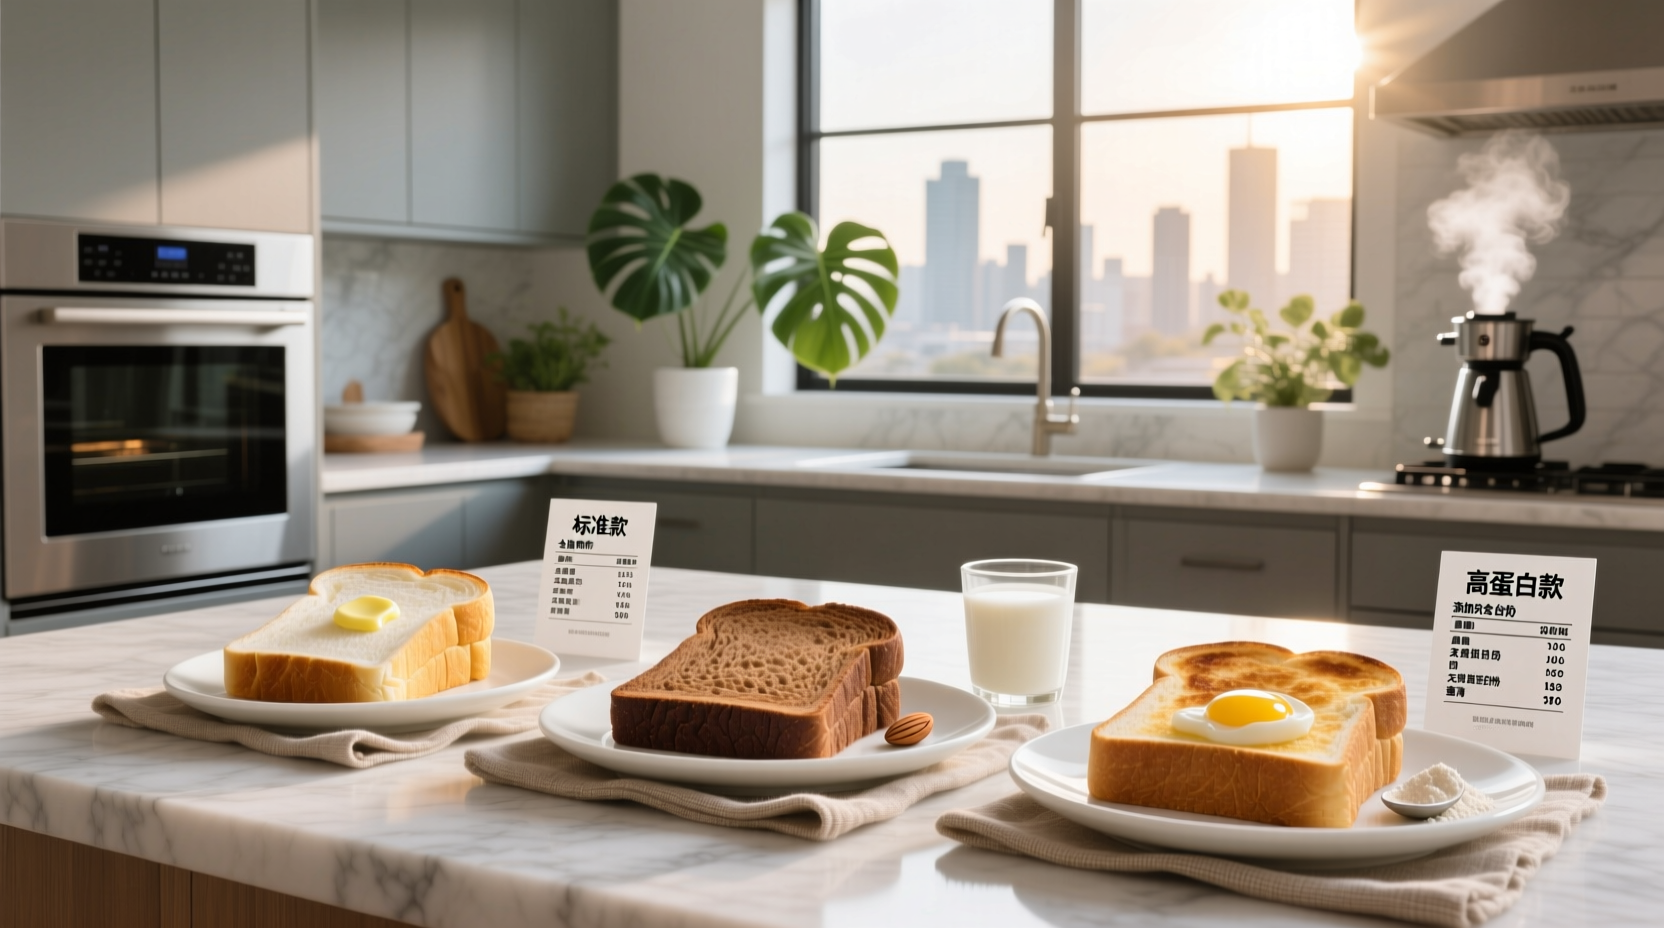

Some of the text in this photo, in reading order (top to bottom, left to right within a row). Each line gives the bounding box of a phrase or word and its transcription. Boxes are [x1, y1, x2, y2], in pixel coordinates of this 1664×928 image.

[572, 514, 628, 537] 标准款
[1466, 569, 1564, 600] 高蛋白款
